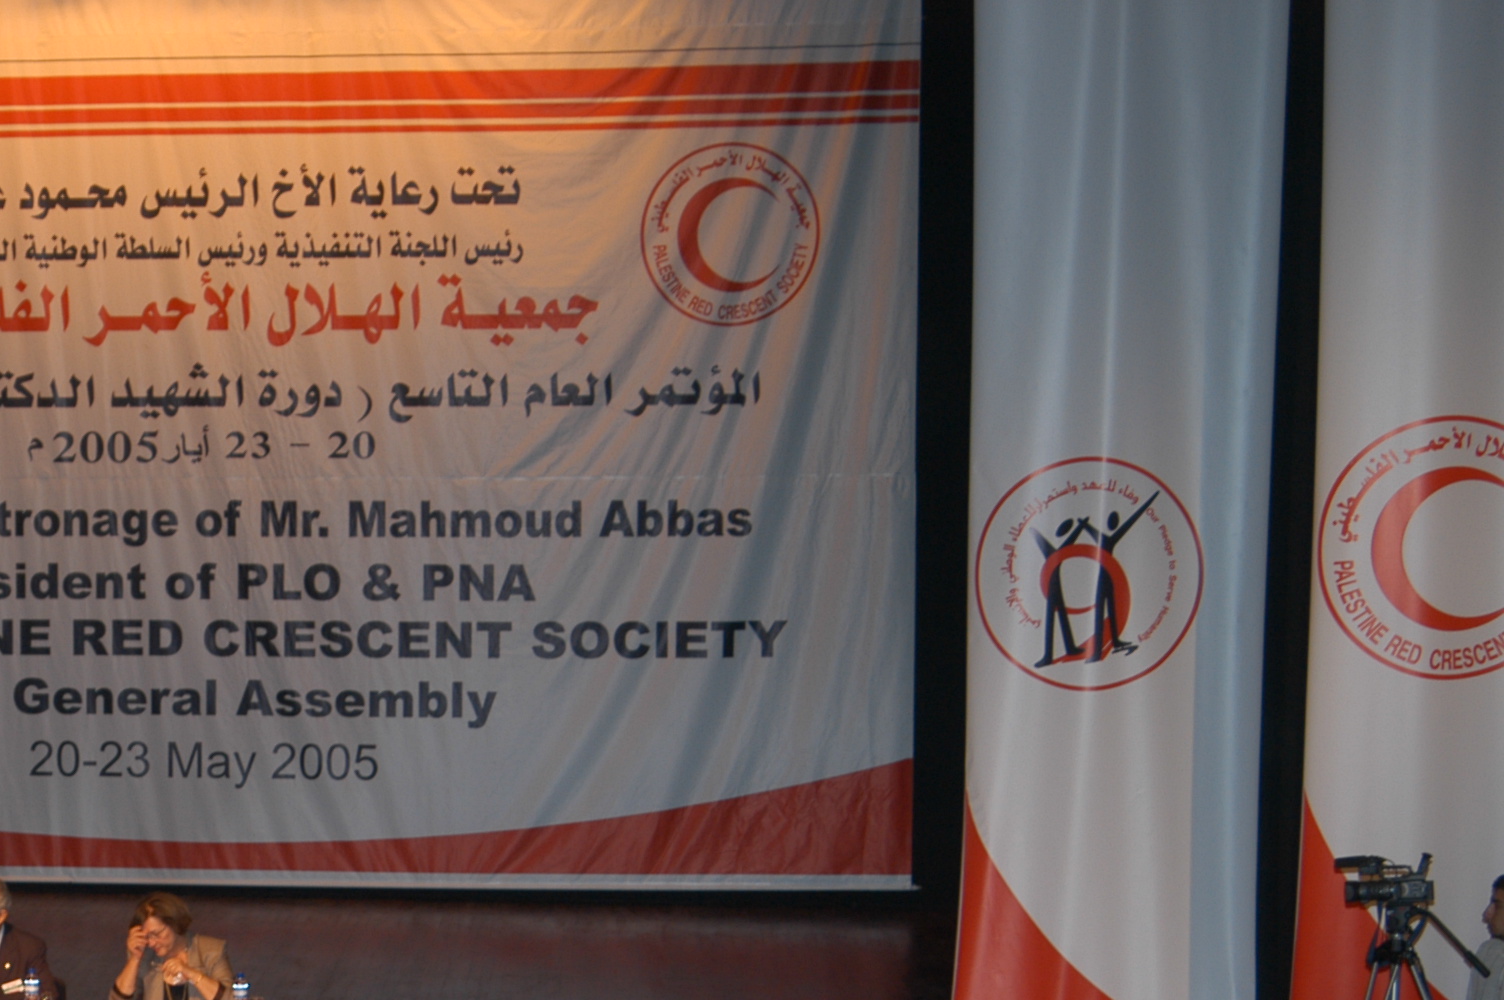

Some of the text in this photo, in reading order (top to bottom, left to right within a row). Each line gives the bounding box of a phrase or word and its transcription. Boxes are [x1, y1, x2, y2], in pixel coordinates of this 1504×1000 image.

[19, 182, 128, 220] محمود
[140, 167, 259, 220] الرئيس
[272, 163, 336, 219] الأخ
[348, 166, 439, 219] رعاية
[450, 165, 521, 205] تحت
[23, 234, 107, 269] الوطنية
[114, 232, 191, 261] السلطة
[197, 231, 268, 268] ورئيس
[274, 231, 382, 268] التنفيذية
[388, 230, 457, 266] اللجنة
[464, 229, 524, 266] رئيس
[652, 242, 809, 320] PALESTINE RED CRESCENT SOCIETY
[83, 270, 251, 346] الأحمر
[267, 282, 420, 346] الهلال
[436, 273, 599, 346] جمعية
[110, 361, 244, 419] الشهيد
[258, 369, 342, 418] دورة
[389, 369, 508, 424] التاسع
[524, 372, 613, 418] العام
[627, 365, 761, 417] المؤتمر
[226, 431, 271, 460] 23
[328, 430, 376, 459] 20
[195, 499, 242, 538] of
[260, 500, 329, 538] Mr.
[348, 500, 582, 538] Mahmoud
[599, 499, 753, 538] Abbas
[165, 562, 217, 601] of
[237, 562, 341, 602] PLO
[362, 563, 401, 602] &
[423, 563, 536, 602] PNA
[1333, 559, 1504, 671] PALESTINE RED CRESCEN
[72, 619, 183, 657] RED
[204, 619, 512, 659] CRESCENT
[532, 620, 789, 660] SOCIETY
[13, 677, 217, 716] General
[236, 679, 497, 729] Assembly
[29, 740, 379, 789] 20-23 May 2005
